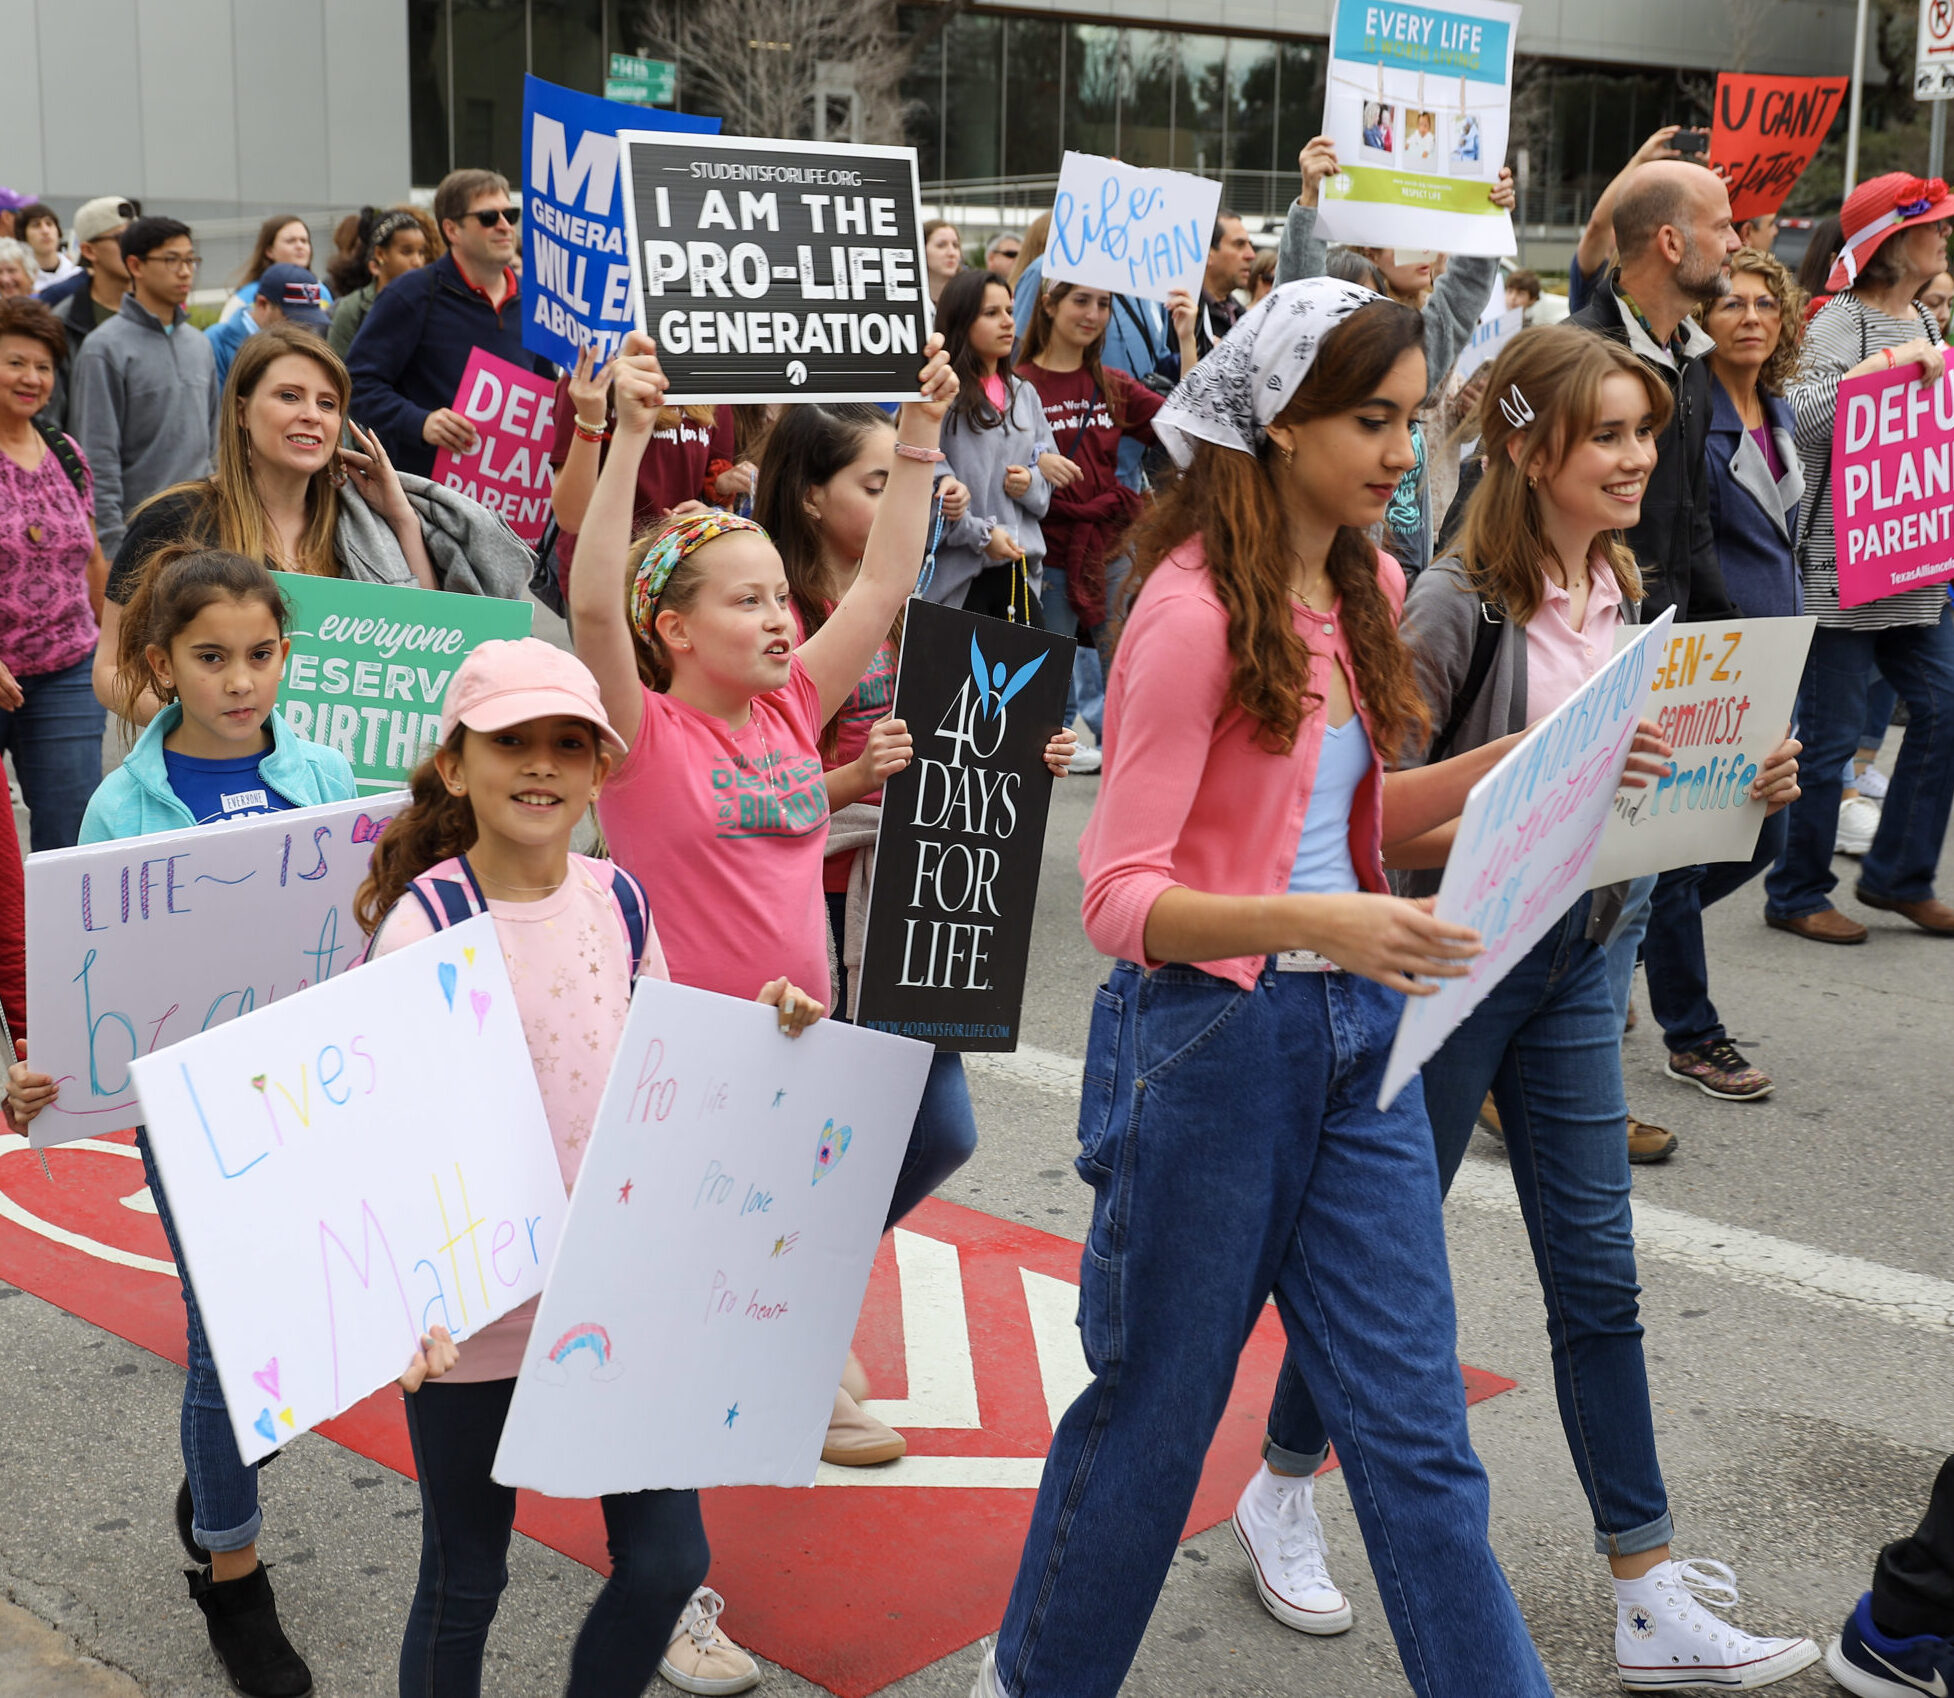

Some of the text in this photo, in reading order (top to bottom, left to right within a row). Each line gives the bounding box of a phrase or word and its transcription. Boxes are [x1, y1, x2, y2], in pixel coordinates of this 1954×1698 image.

[1364, 36, 1480, 71] IS WORTH LIVING
[1365, 6, 1483, 54] EVERY LIFE
[1721, 84, 1841, 139] U CANT
[531, 111, 620, 217] M
[689, 161, 862, 187] STUDENTSFORLIFE.ORG
[531, 197, 629, 256] GENERA
[655, 186, 899, 236] I AM THE
[533, 228, 591, 317] WILL
[644, 239, 918, 301] PRO-LIFE
[1128, 219, 1203, 288] MAN
[533, 293, 632, 365] ABORTI
[658, 310, 918, 355] GENERATION
[464, 368, 555, 441] DEF
[1844, 369, 1954, 455] DEFU
[450, 434, 555, 490] PLAN
[1844, 440, 1954, 518] PLAN
[444, 471, 552, 524] PARENT
[1848, 503, 1954, 565] PARENT
[1890, 556, 1954, 585] TexasAlliancef
[318, 614, 465, 659] everyone
[280, 653, 451, 703] ESERV
[934, 673, 1007, 768] 40
[226, 791, 263, 810] EVERYONE
[909, 757, 1021, 839] DAYS
[1614, 753, 1758, 827] nd Prolife
[82, 825, 332, 932] LIFE IS
[909, 839, 1001, 916] FOR
[896, 918, 993, 990] LIFE
[180, 1035, 377, 1179] Lives
[626, 1038, 678, 1123] Pro
[692, 1159, 773, 1216] Pro love
[319, 1162, 541, 1410] Matter
[704, 1268, 789, 1325] Pro heart
